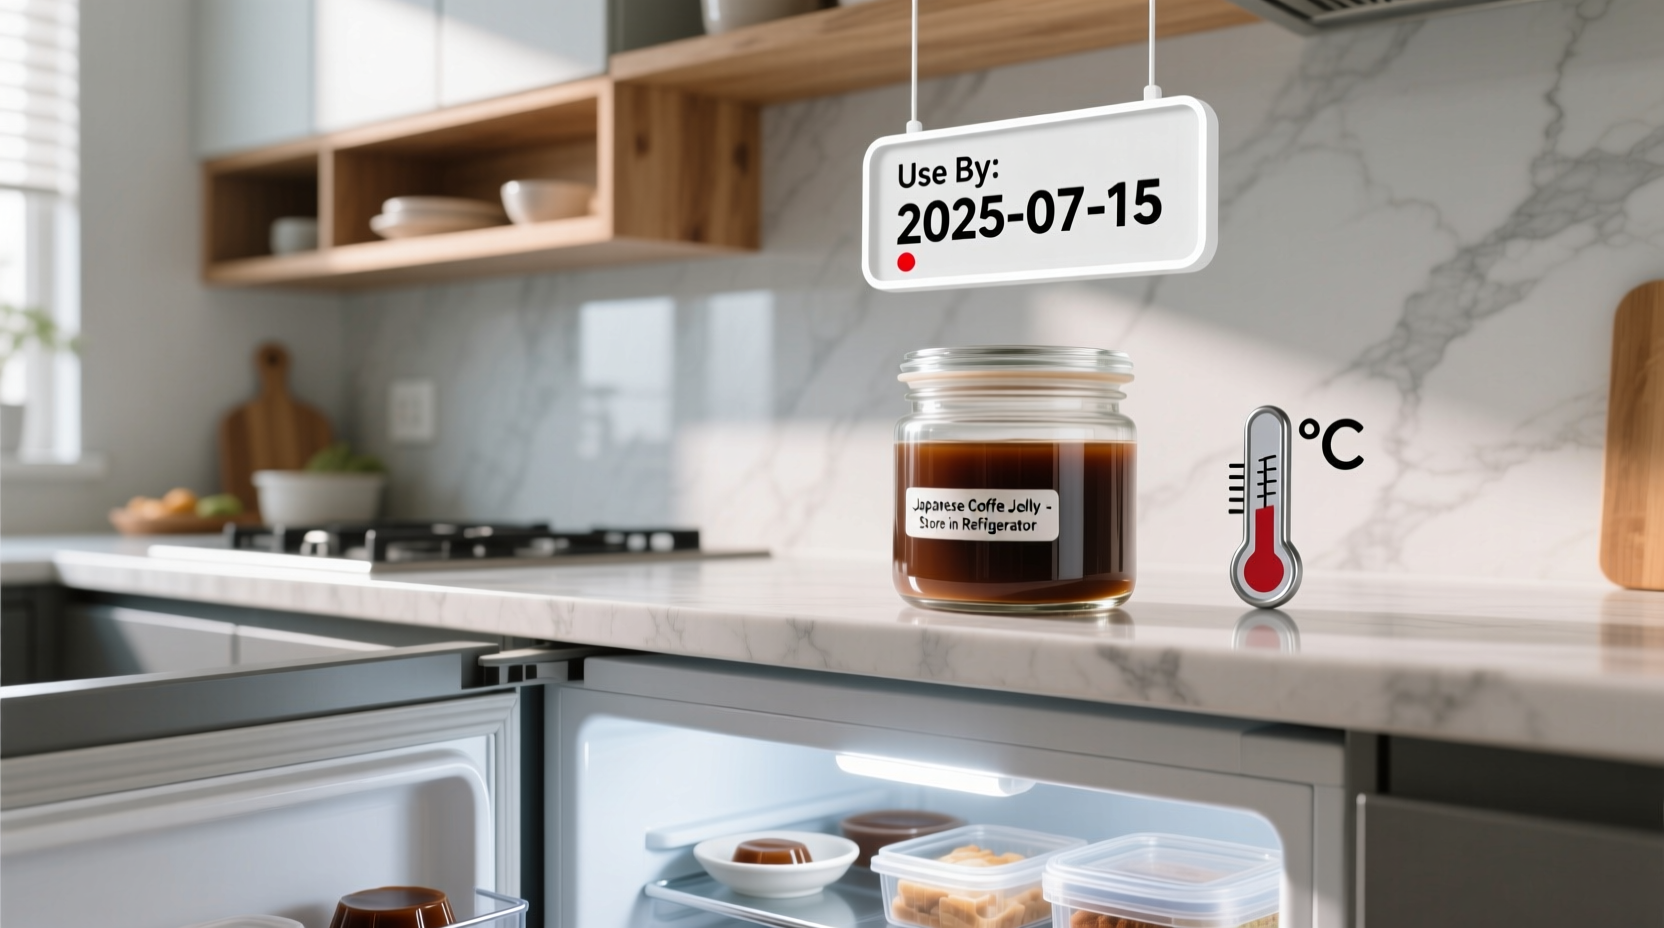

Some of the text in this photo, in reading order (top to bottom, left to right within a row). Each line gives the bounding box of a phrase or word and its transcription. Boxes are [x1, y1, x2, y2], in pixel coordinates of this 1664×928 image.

[898, 156, 999, 188] Use By:
[896, 177, 1163, 246] 2025-07-15
[968, 498, 1005, 513] Coffe
[949, 516, 959, 530] in
